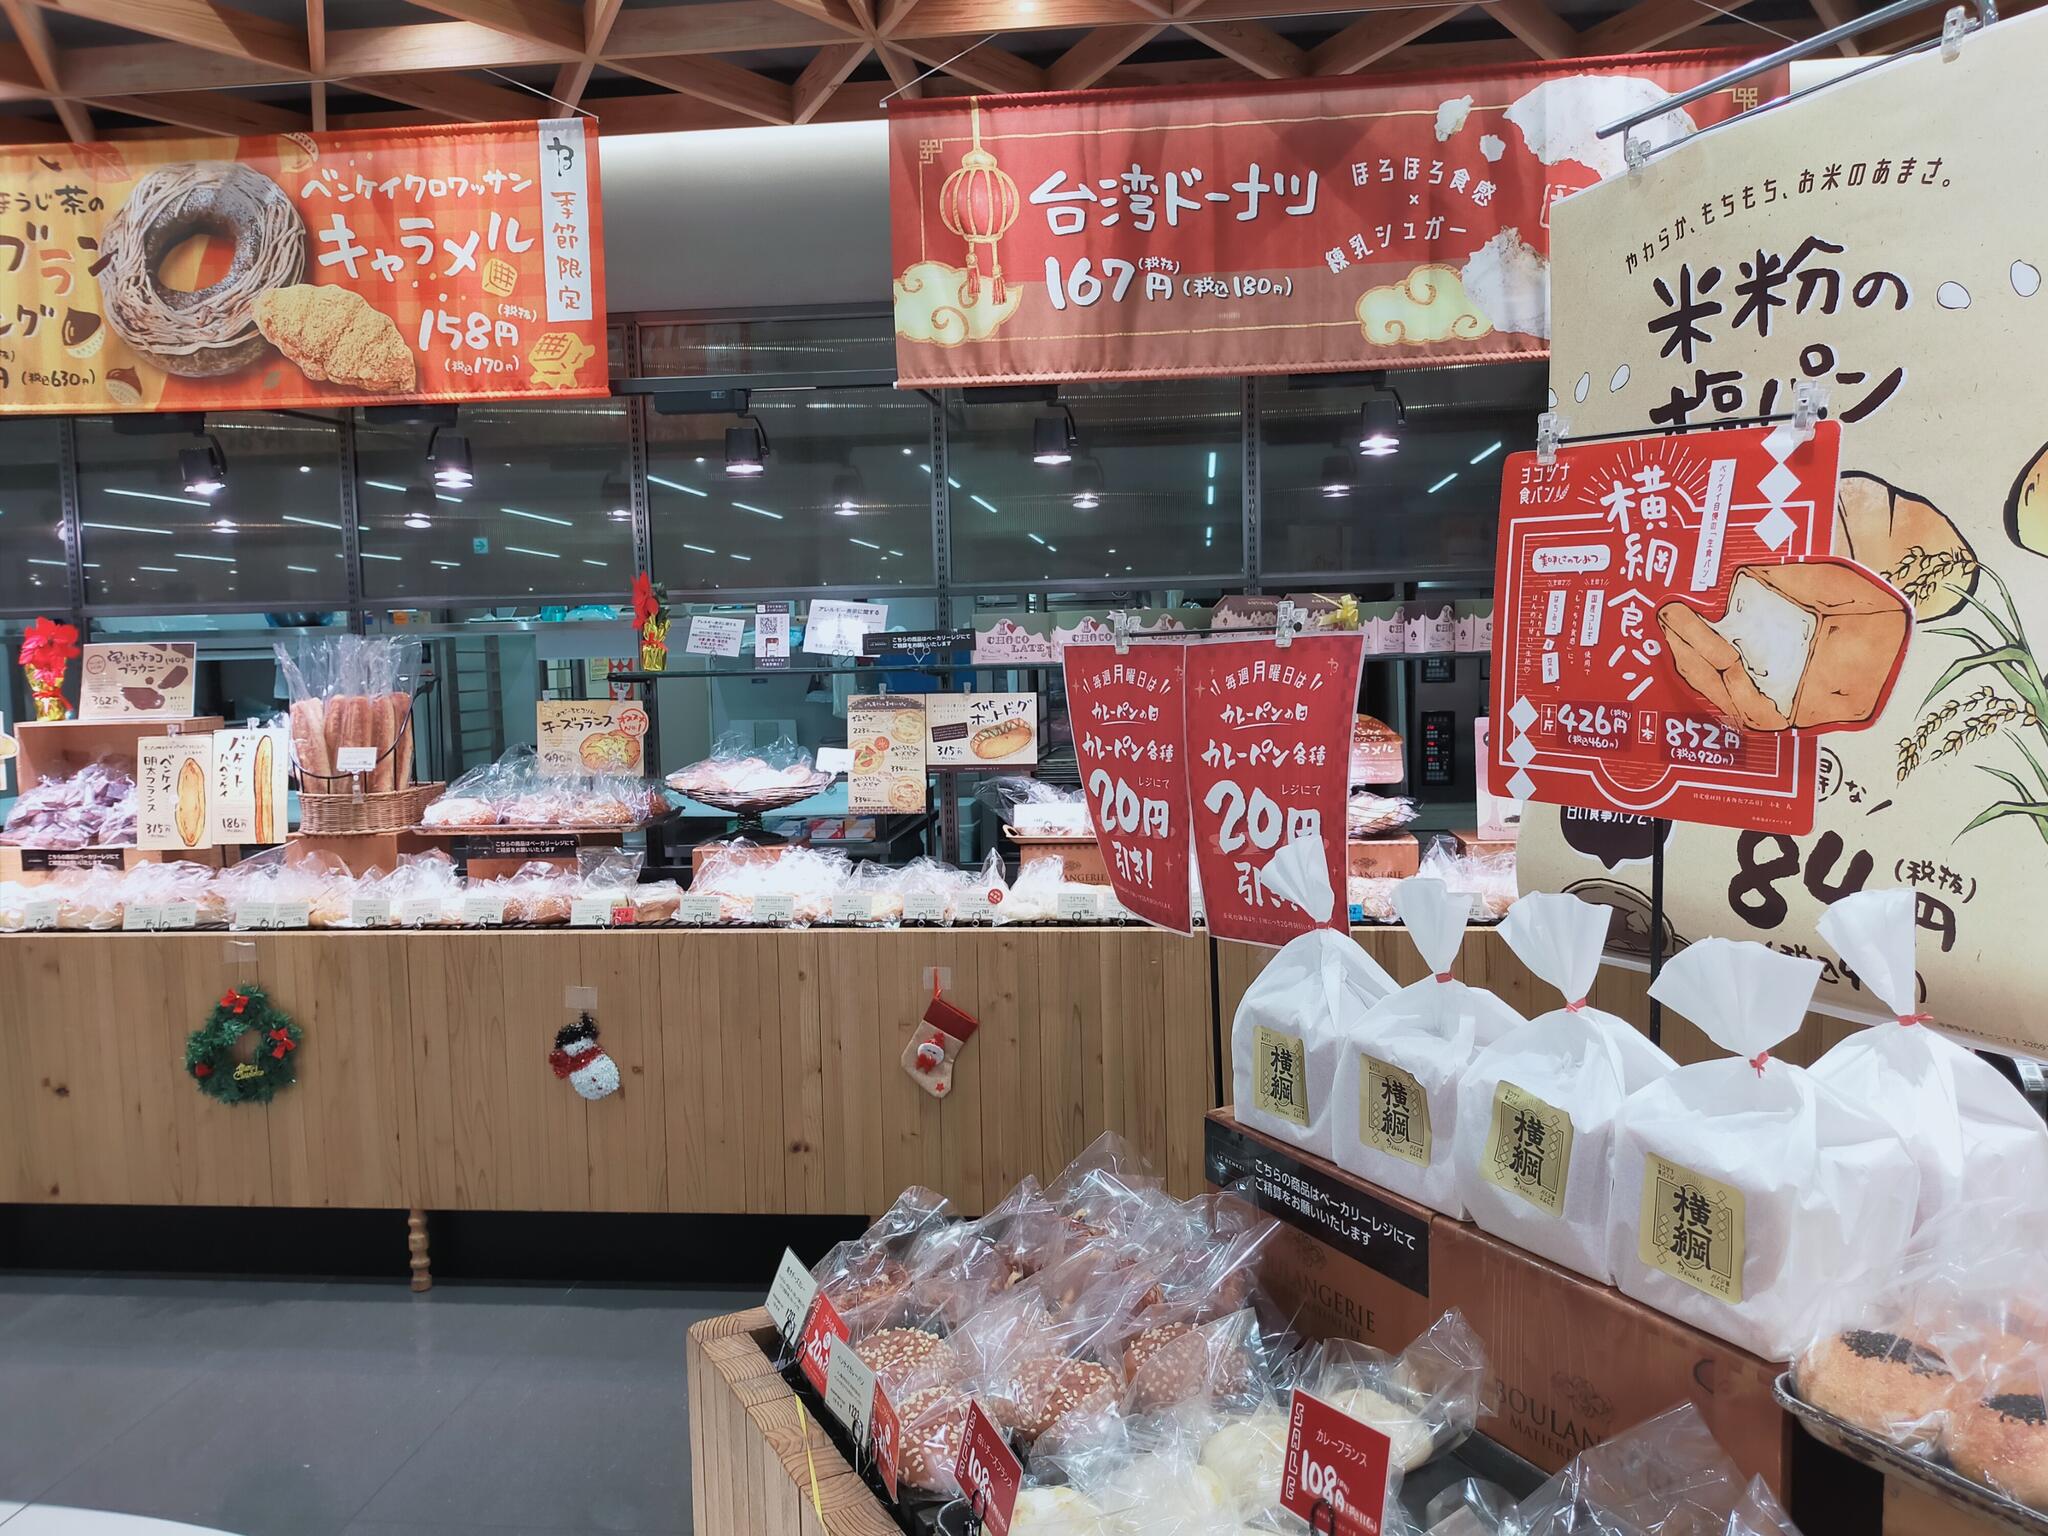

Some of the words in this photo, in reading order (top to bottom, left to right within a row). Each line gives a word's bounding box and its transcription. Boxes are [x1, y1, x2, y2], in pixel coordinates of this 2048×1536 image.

[301, 168, 532, 203] ベンケイクロワッサン
[1029, 163, 1318, 236] 台湾ドーナツ
[1352, 156, 1497, 207] ほろほろ食感
[1624, 156, 1952, 275] やわらか、もちもち、お米のあまさ。
[318, 211, 535, 283] キャラメル
[551, 191, 583, 311] 季節限定
[1324, 216, 1467, 275] 練乳シュガー
[1043, 256, 1172, 310] 167円
[1183, 275, 1294, 299] (税込180円)
[1648, 236, 1910, 364] 米粉の
[419, 308, 520, 352] 158円
[21, 368, 96, 387] (税込630円)
[445, 354, 520, 376] (税込170円)
[1519, 487, 1555, 505] 食パン
[1092, 664, 1157, 693] 毎週月曜日は
[1225, 660, 1307, 690] 毎週月曜日は
[542, 715, 615, 734] チーズフランス
[970, 699, 1033, 725] ホットドッグ
[971, 700, 996, 711] THE
[1091, 701, 1160, 723] カレーパンの日
[1220, 701, 1309, 723] カレーパンの日
[1557, 703, 1628, 736] 426円
[1665, 717, 1741, 750] 852円
[1088, 768, 1170, 839] 20円
[1137, 776, 1171, 790] レジにて
[1281, 784, 1322, 797] レジにて
[1203, 779, 1322, 855] 20円
[1894, 858, 1977, 904] (税抜)
[1381, 1077, 1410, 1142] 横綱
[1509, 1110, 1546, 1186] 横綱
[1254, 1158, 1416, 1251] こちらの商品はベーカリーレジにて
[1254, 1176, 1372, 1246] ご精算をお願いいたします
[1670, 1185, 1713, 1271] 横綱
[1286, 1402, 1305, 1501] SALE
[1315, 1428, 1368, 1468] カレーフランス
[1301, 1449, 1345, 1512] 108円
